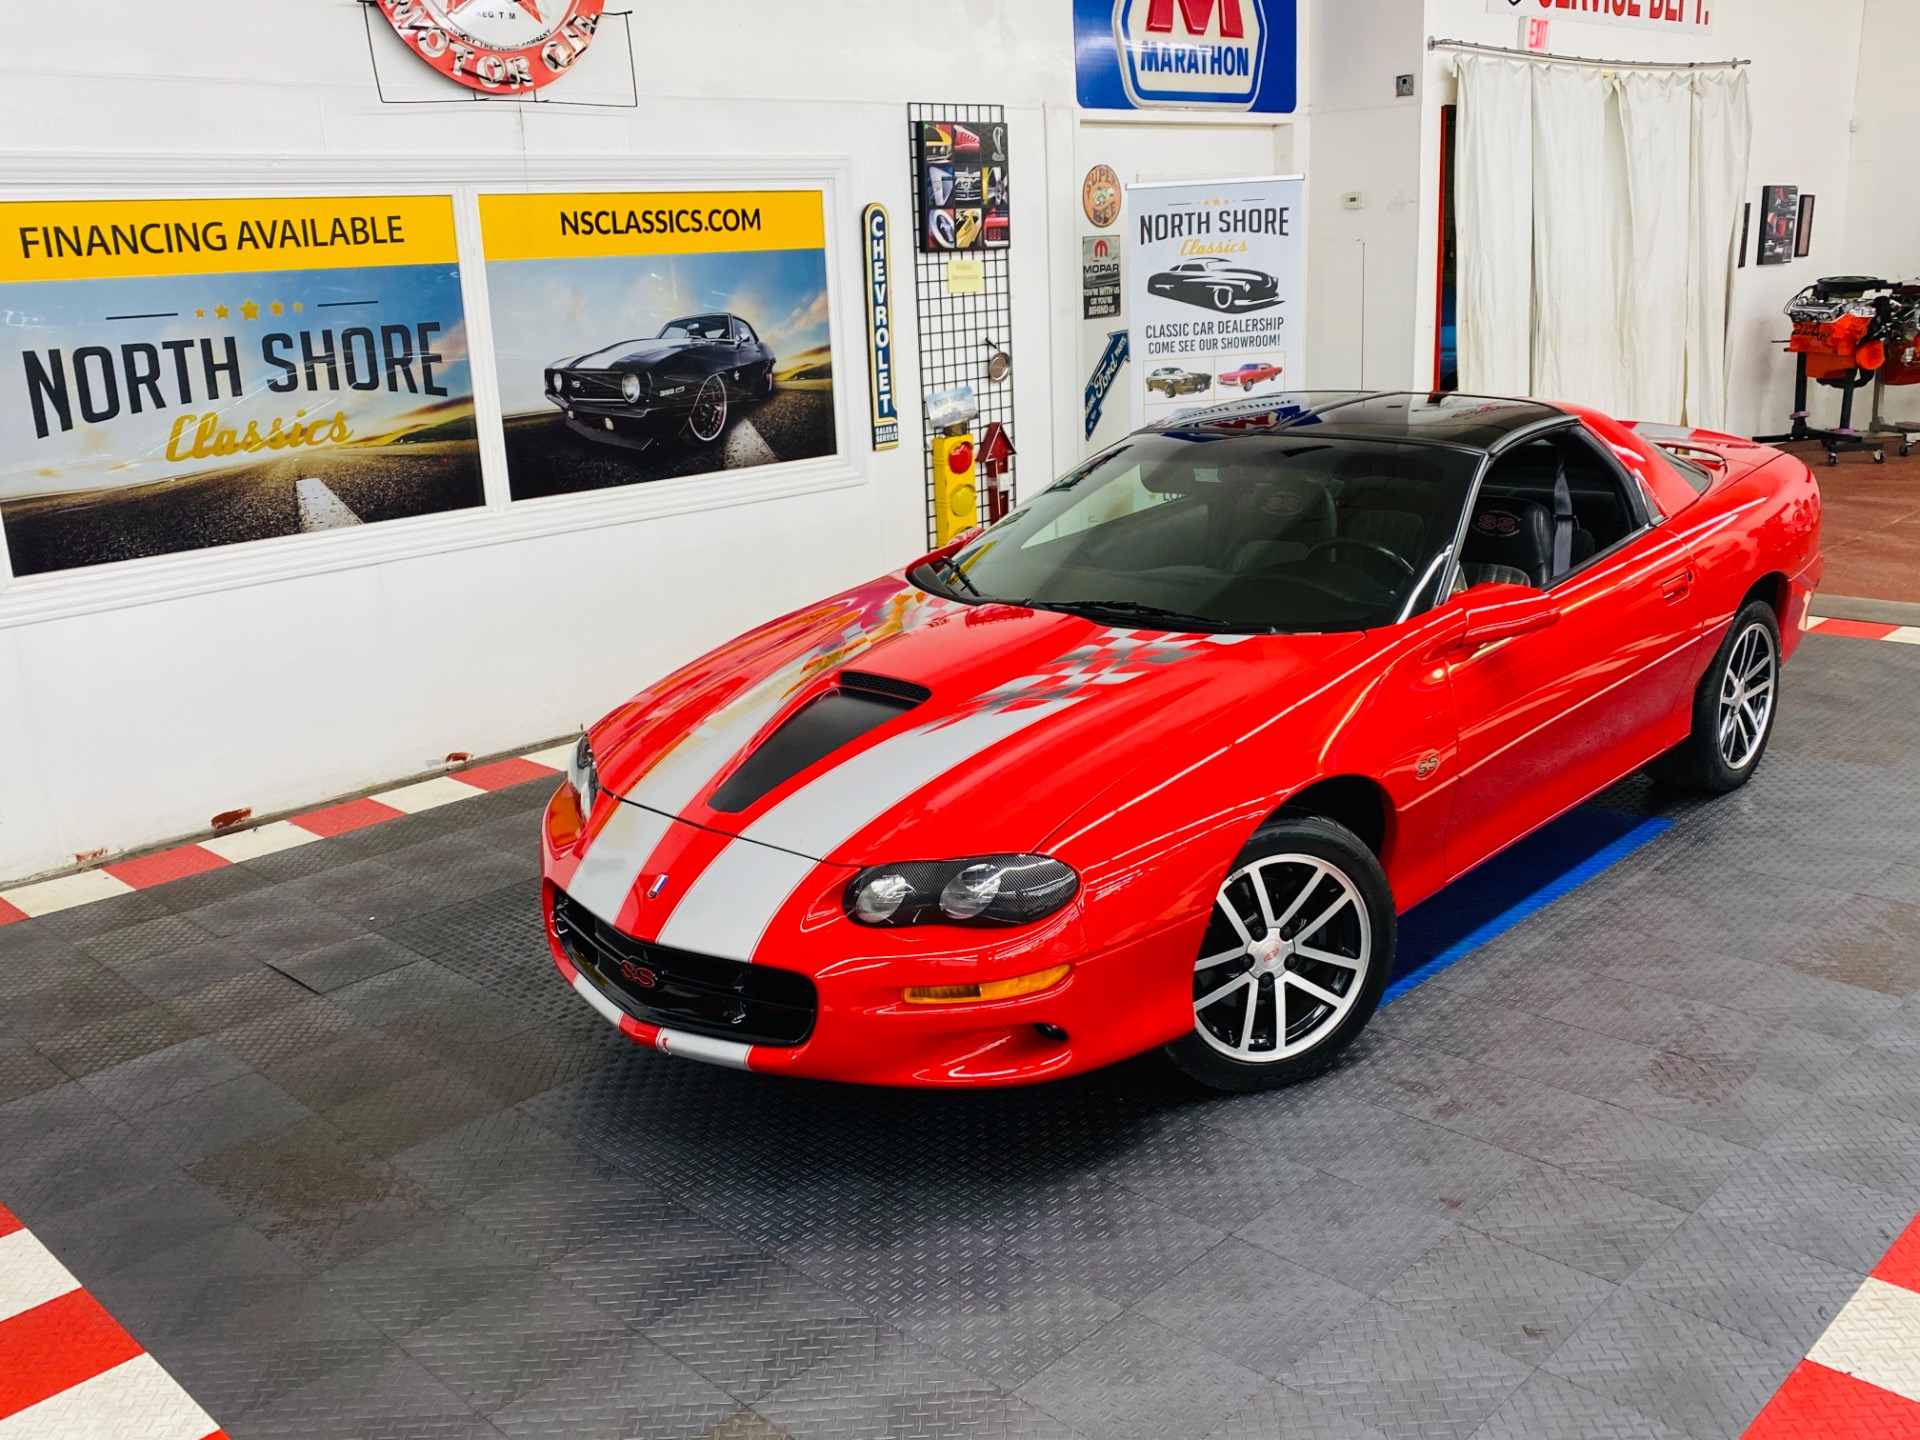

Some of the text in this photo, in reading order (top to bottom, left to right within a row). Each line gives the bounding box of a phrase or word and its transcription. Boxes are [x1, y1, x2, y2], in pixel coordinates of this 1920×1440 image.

[1528, 18, 1549, 49] EXIT
[1140, 40, 1249, 77] MARATHON
[19, 215, 405, 259] FINANCING AVAILABLE
[560, 208, 762, 236] NSCLASSICS.COM
[1140, 207, 1289, 245] NORTH SHORE
[1180, 238, 1249, 256] Classics
[1083, 263, 1120, 274] MOPAR
[871, 215, 892, 414] CHEVROLET
[1145, 317, 1284, 339] CLASSIC CAR DEALERSHIP
[1148, 334, 1281, 354] COME SEE OUR SHOWROOM!
[22, 321, 448, 439] NORTH SHORE
[1094, 353, 1118, 399] Ford
[165, 409, 354, 463] Classics
[875, 426, 892, 435] SALES
[1417, 754, 1438, 776] SS
[620, 959, 656, 988] SS
